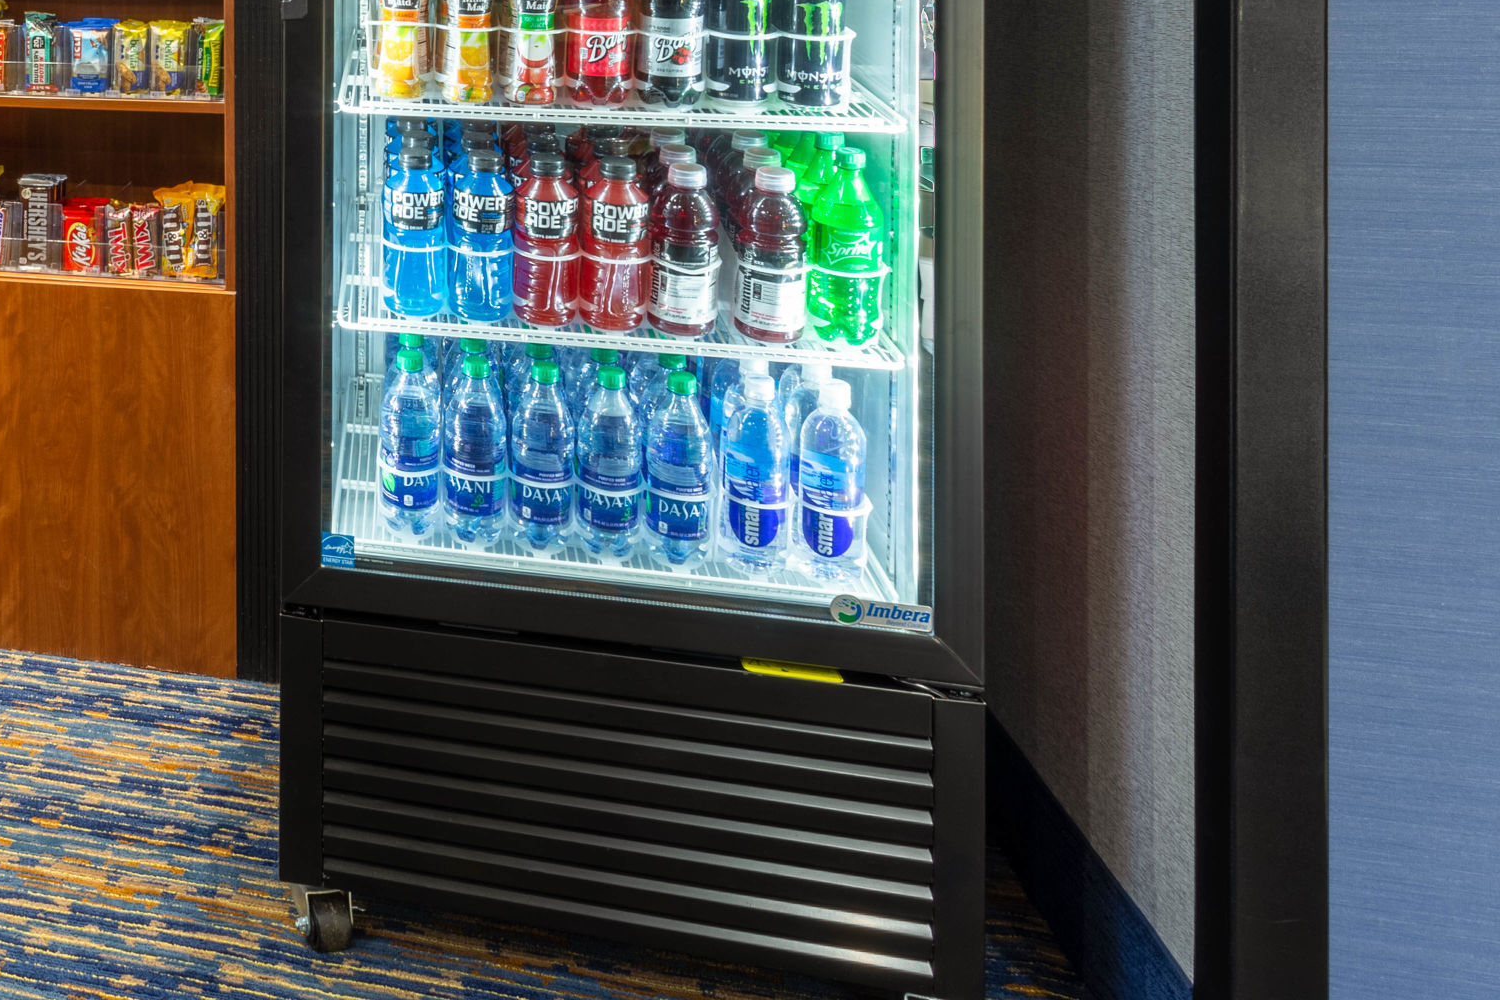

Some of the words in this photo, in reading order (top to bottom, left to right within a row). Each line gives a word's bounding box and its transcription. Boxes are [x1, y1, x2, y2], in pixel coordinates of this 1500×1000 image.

[393, 189, 444, 206] POWER
[453, 189, 506, 210] POWER
[526, 199, 578, 215] POWER
[593, 202, 649, 217] POWER
[27, 191, 48, 261] HERSHEY'S
[866, 603, 931, 624] Imbera
